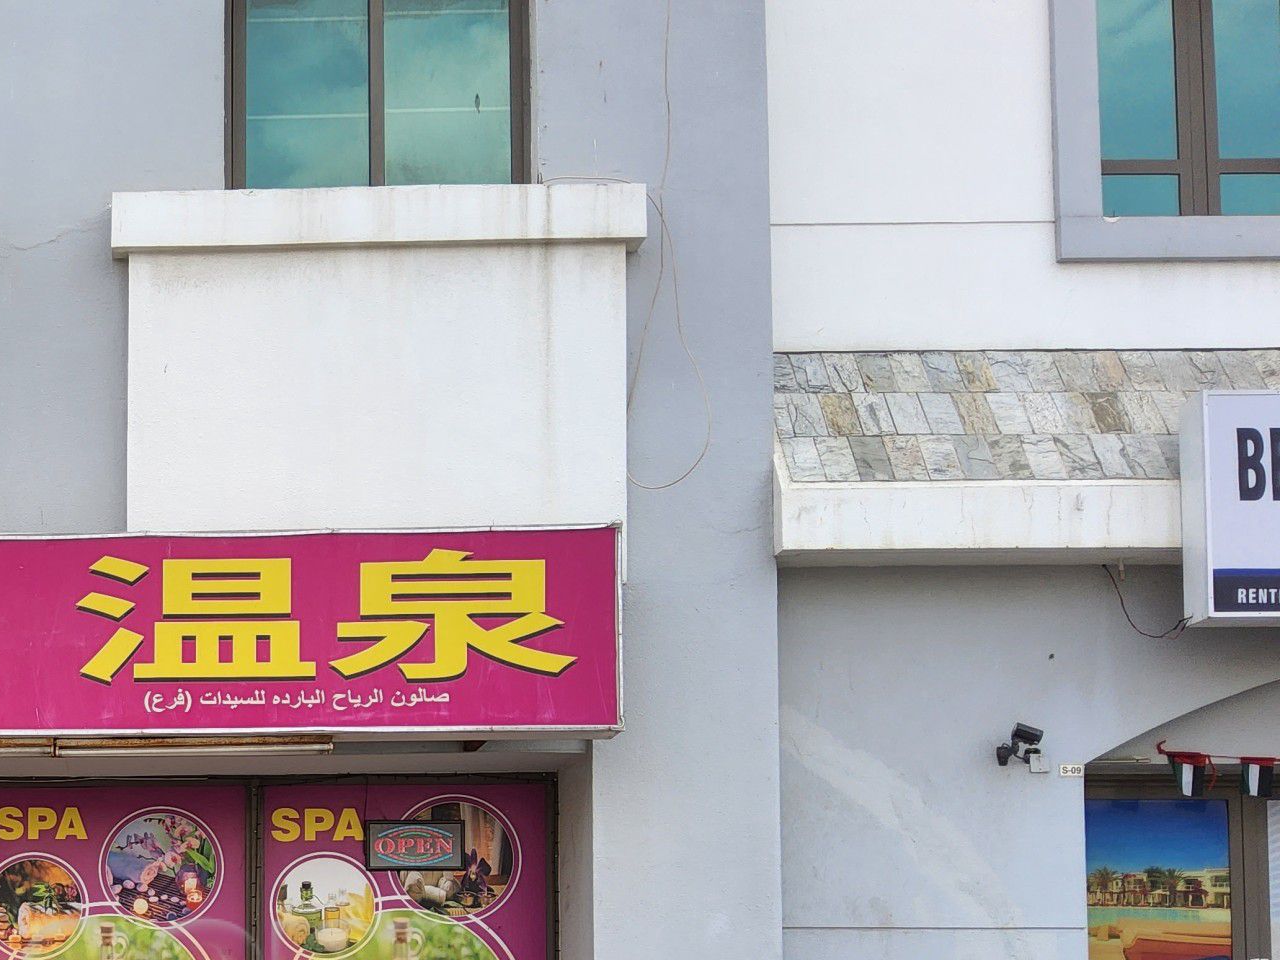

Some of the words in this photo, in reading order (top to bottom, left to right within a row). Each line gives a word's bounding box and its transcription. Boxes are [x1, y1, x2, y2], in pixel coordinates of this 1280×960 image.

[1237, 588, 1280, 604] RENT
[75, 548, 577, 683] 温泉
[143, 688, 193, 713] (فرع)
[199, 689, 266, 709] للسيدات
[272, 688, 326, 709] البارده
[332, 688, 384, 711] الرياح
[390, 687, 450, 707] صالون
[1061, 766, 1082, 775] S-09
[271, 808, 365, 843] SPA
[373, 836, 454, 855] OPEN
